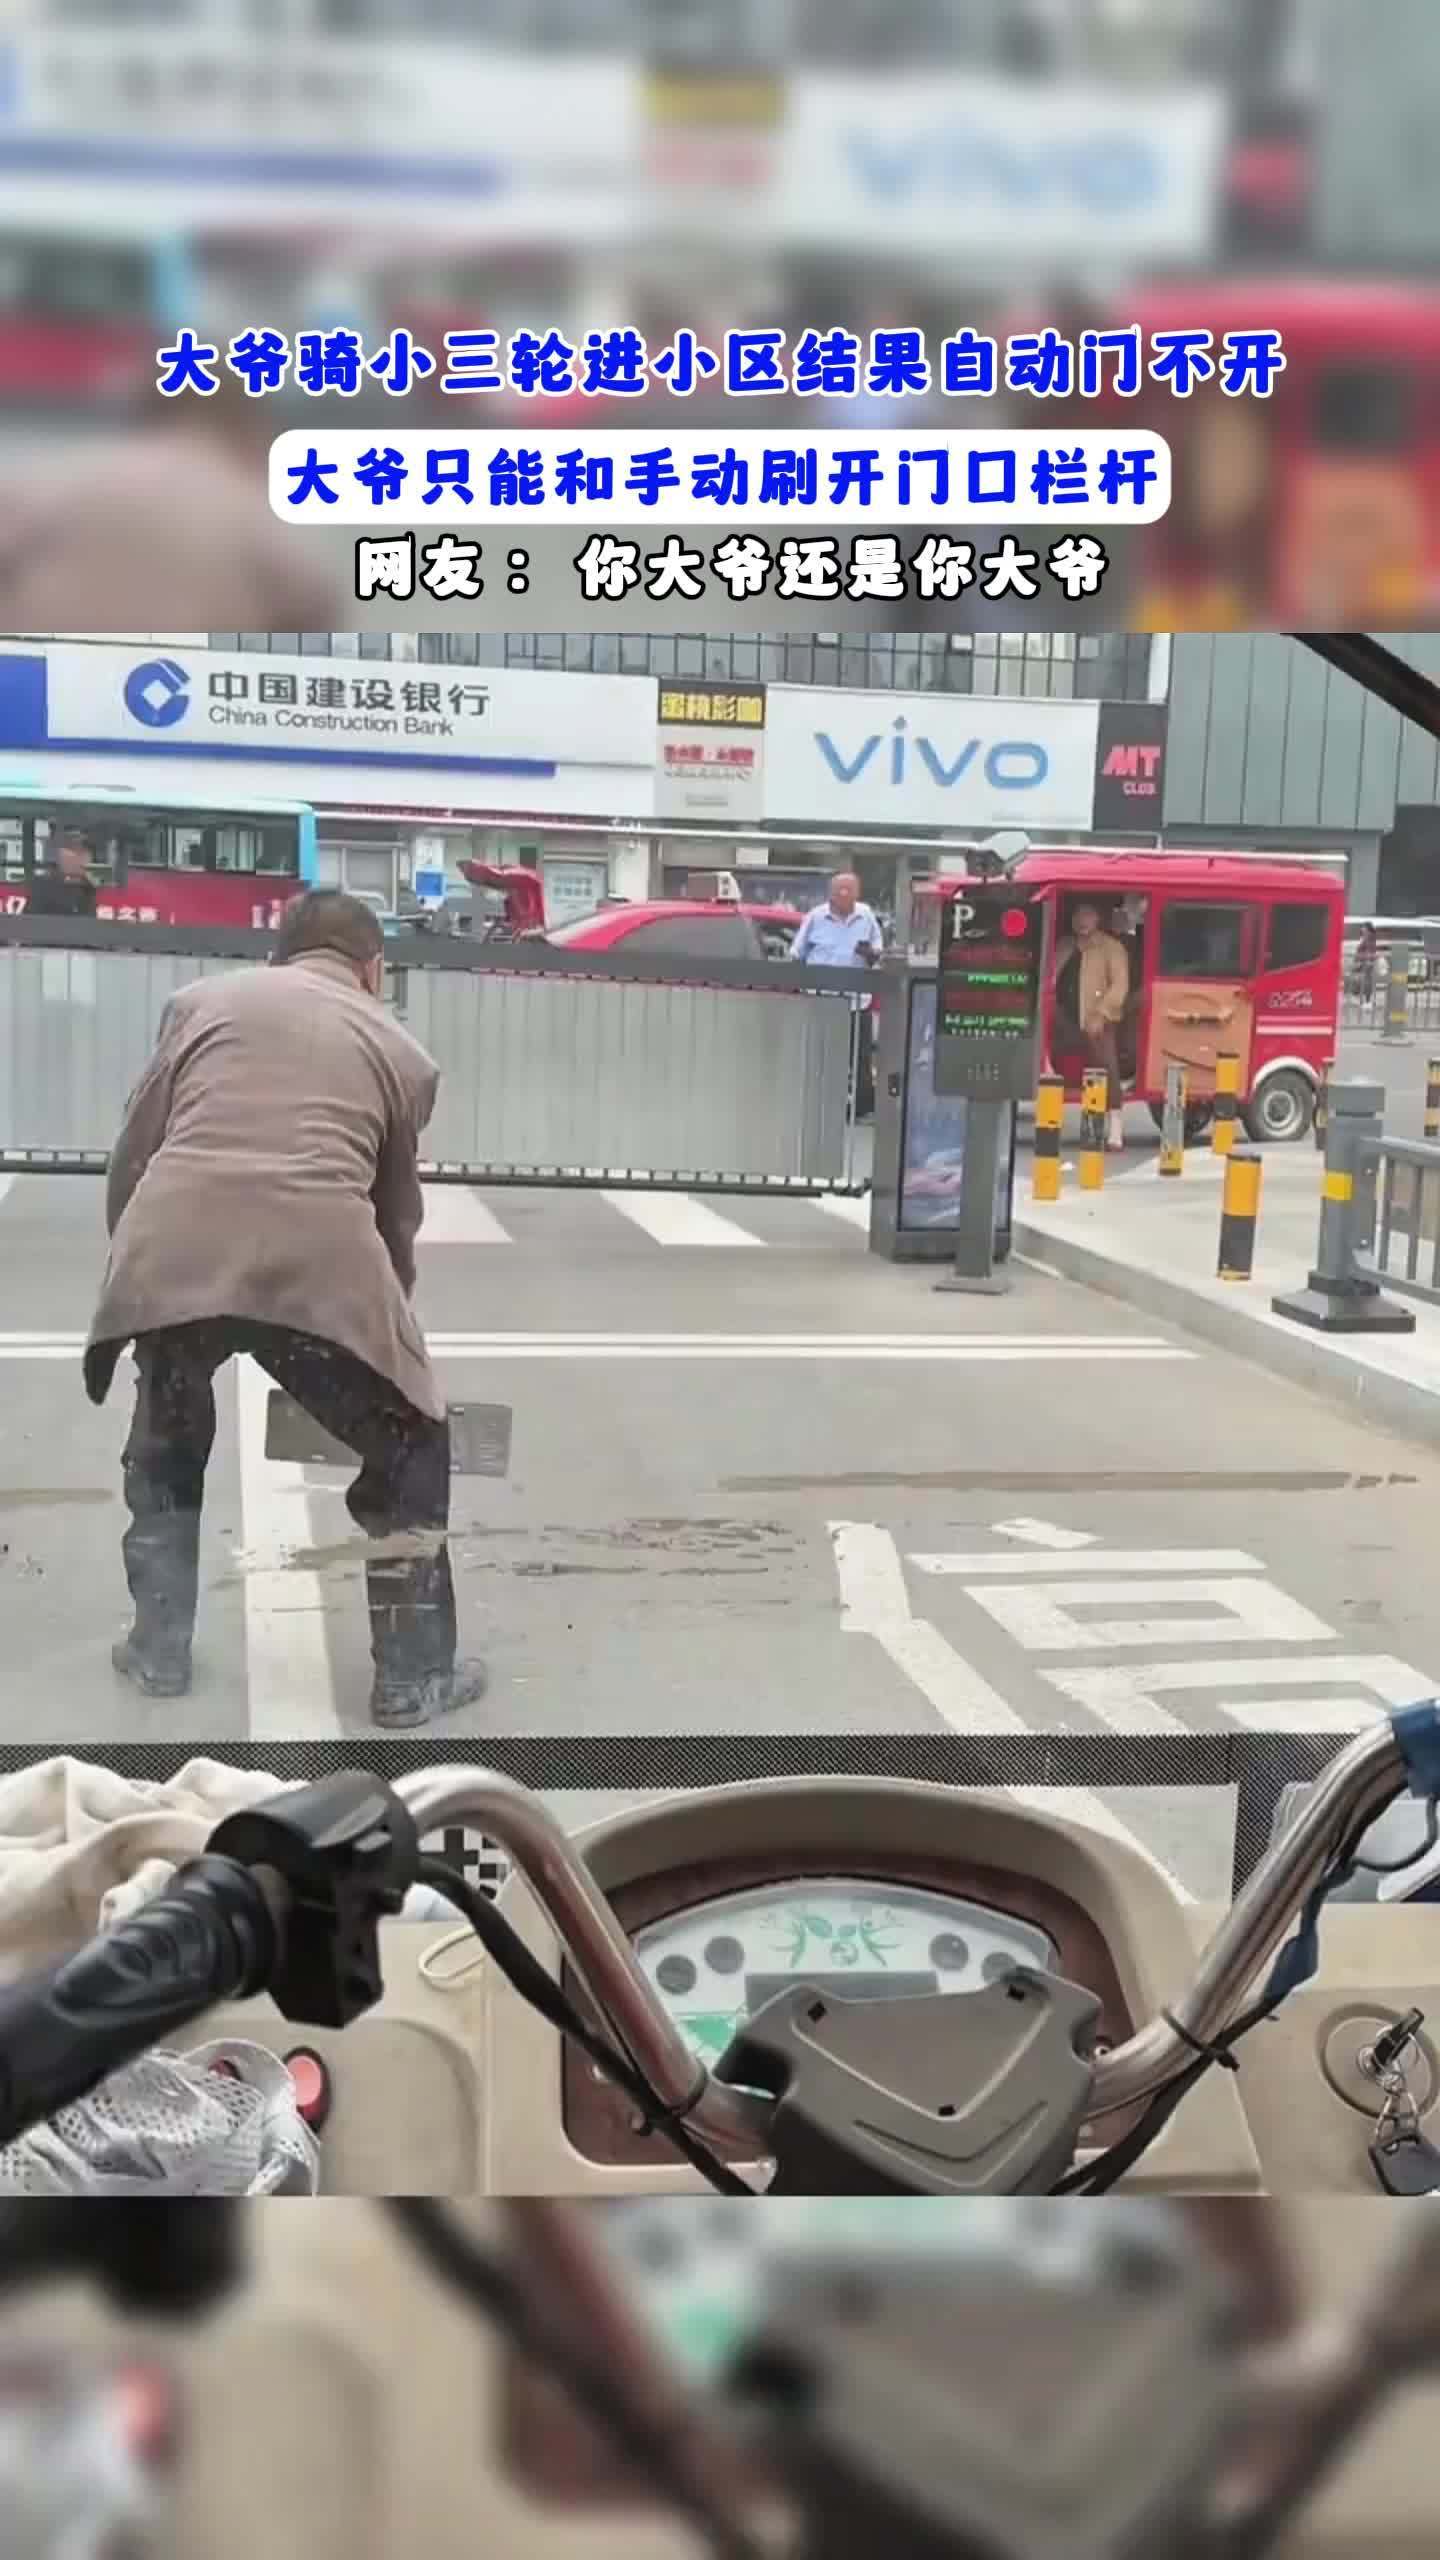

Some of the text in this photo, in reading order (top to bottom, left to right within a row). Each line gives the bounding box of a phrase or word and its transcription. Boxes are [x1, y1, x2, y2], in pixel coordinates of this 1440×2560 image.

[208, 671, 490, 716] 中国建设银行
[208, 704, 454, 737] China Construction Bank
[813, 715, 1049, 791] vivo
